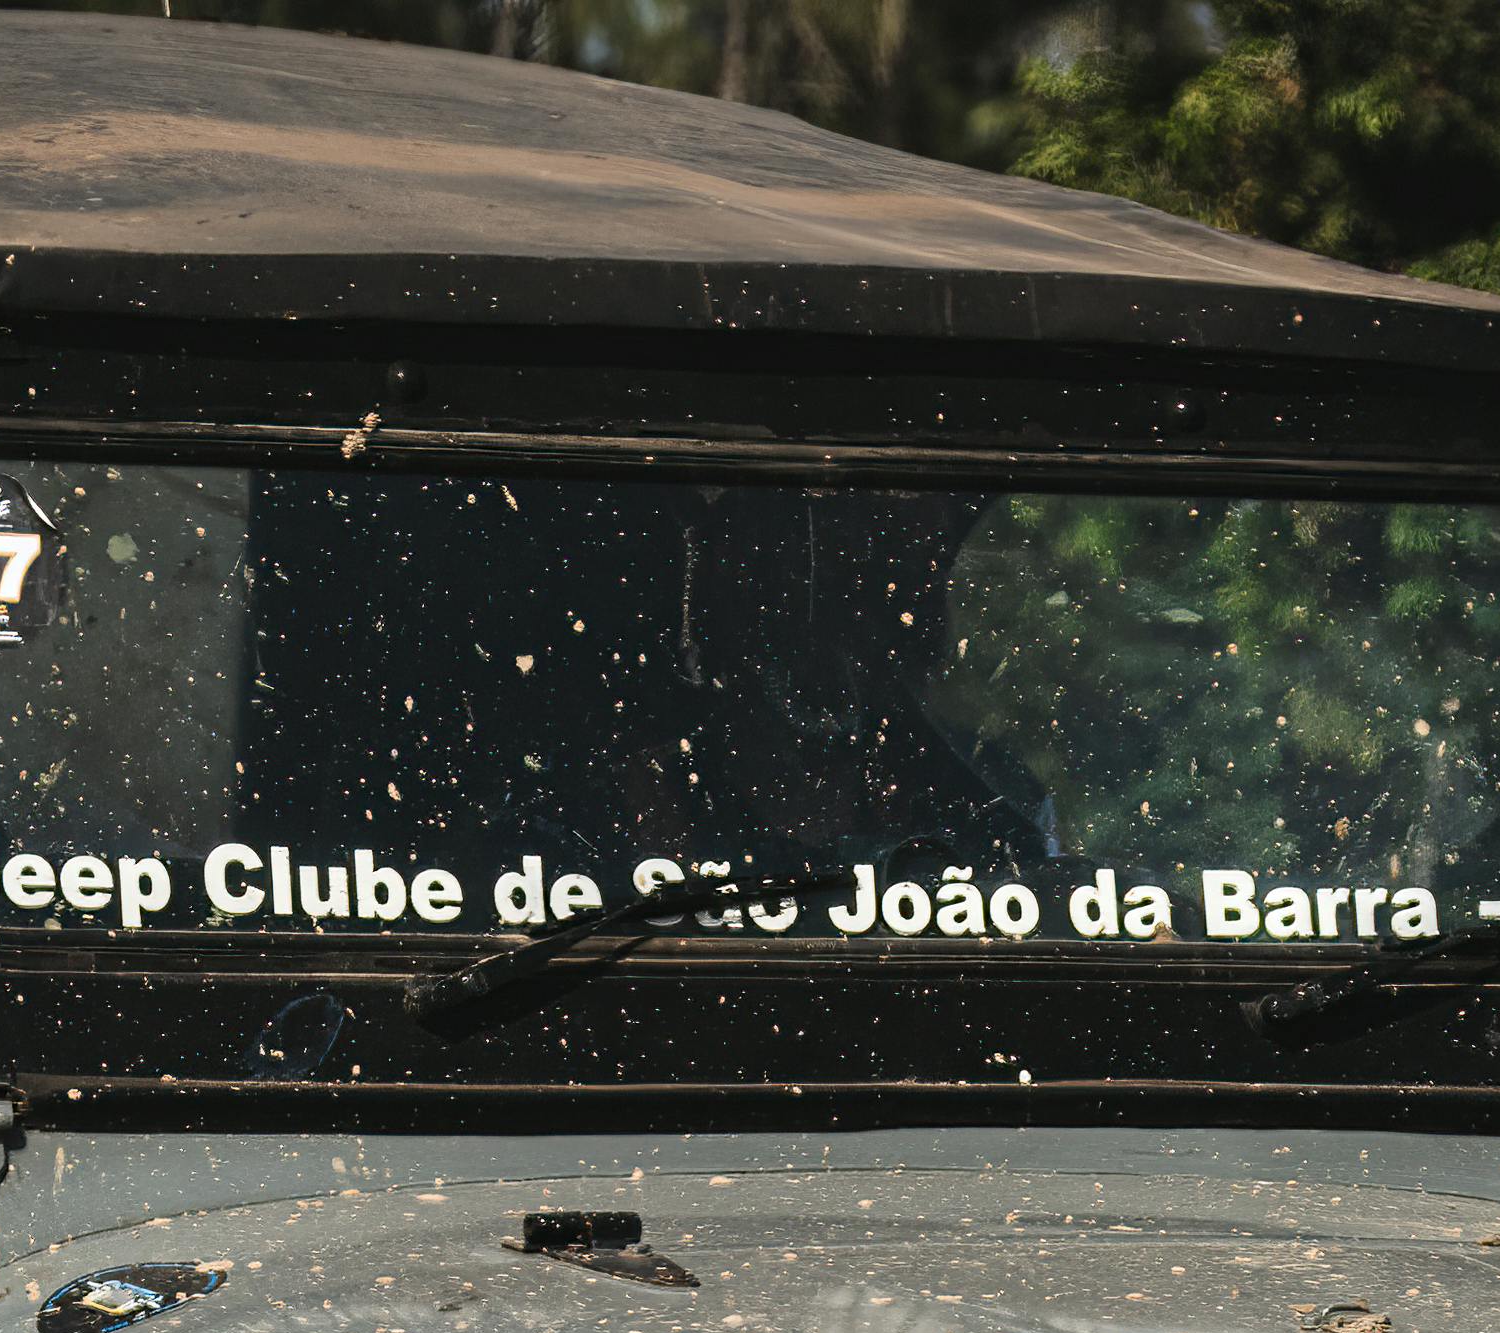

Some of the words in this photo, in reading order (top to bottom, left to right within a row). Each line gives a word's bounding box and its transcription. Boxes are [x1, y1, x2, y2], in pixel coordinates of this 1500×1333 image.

[204, 843, 463, 923] Clube
[494, 855, 602, 924] de
[828, 864, 1040, 936] João
[1069, 868, 1173, 938] da
[1202, 869, 1440, 940] Barra
